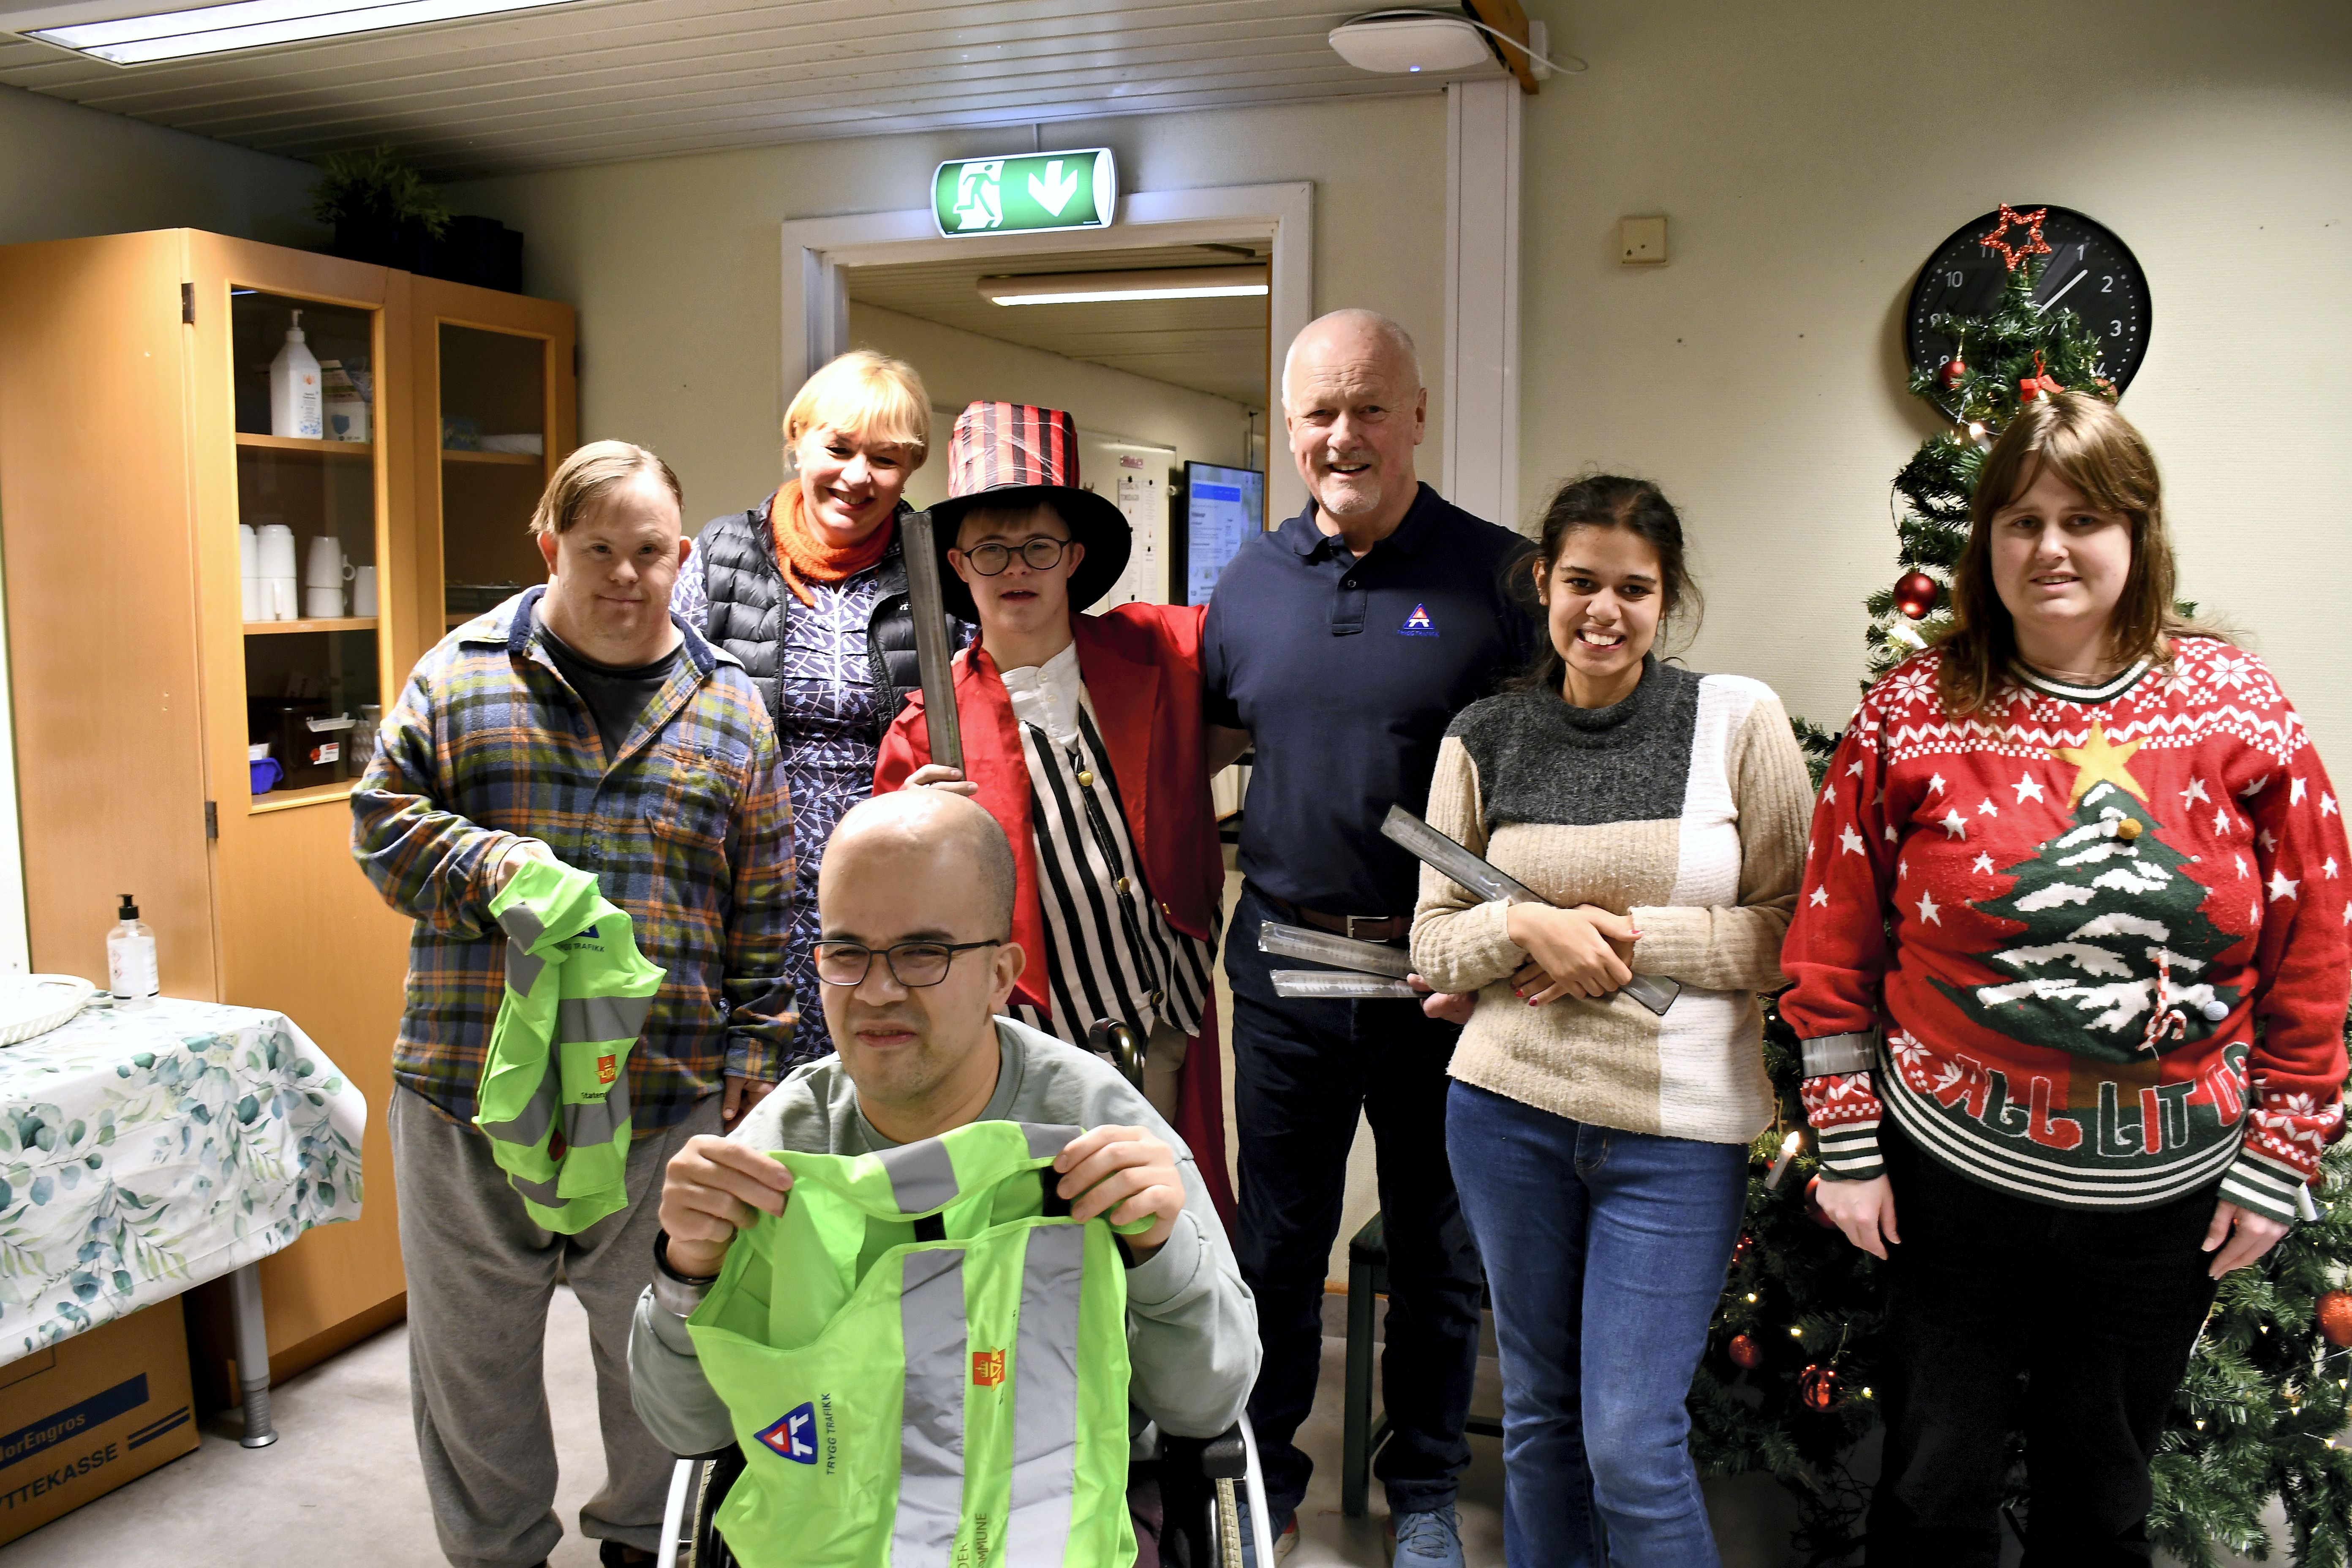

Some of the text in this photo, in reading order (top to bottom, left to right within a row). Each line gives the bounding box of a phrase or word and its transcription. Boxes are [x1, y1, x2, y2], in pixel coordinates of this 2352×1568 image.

[2077, 244, 2084, 261] 1
[1946, 271, 1963, 288] 10
[2101, 275, 2113, 293] 2
[2110, 319, 2122, 337] 3
[2096, 362, 2107, 378] 4
[1932, 1053, 2083, 1151] ALL
[2097, 1079, 2197, 1157] LIT
[821, 1392, 838, 1475] TRYGG TRAFIKK
[974, 1513, 989, 1568] OMMUNE
